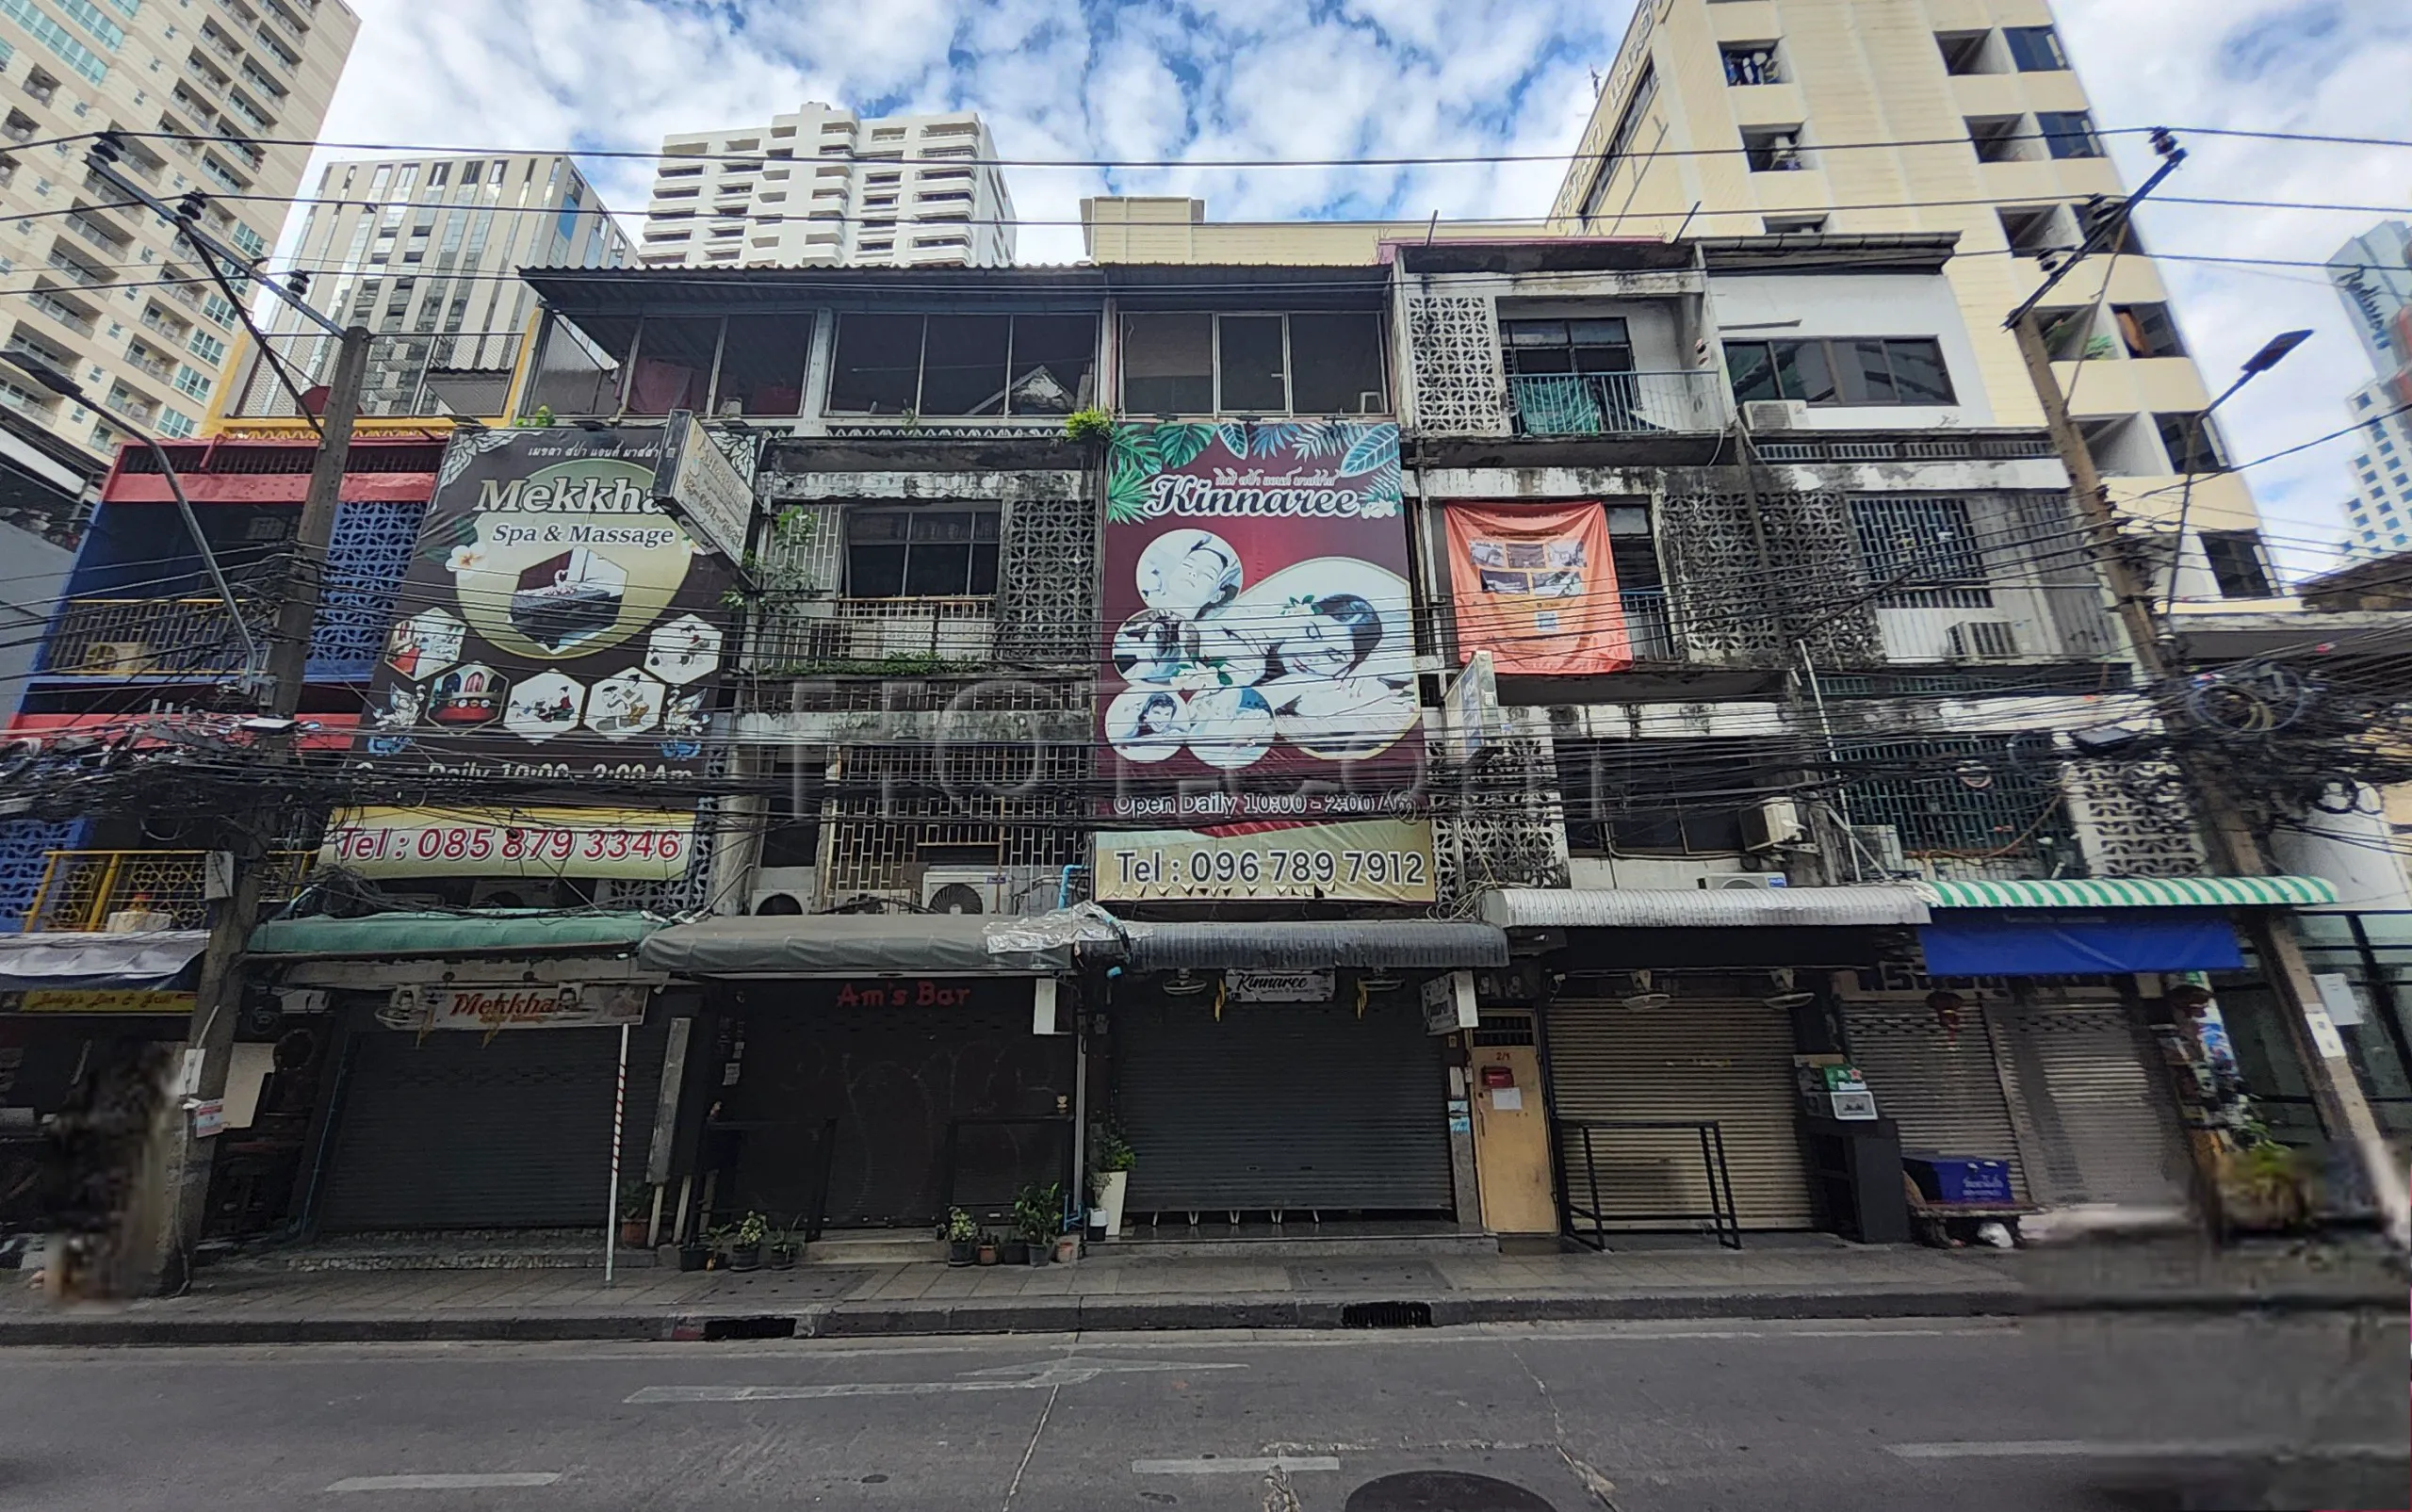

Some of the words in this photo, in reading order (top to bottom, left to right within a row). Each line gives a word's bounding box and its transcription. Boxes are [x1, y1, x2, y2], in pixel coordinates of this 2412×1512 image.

[471, 477, 666, 514] Mekkha
[1144, 475, 1360, 516] Kinnaree
[492, 524, 537, 546] Spa
[544, 525, 563, 543] &
[568, 525, 675, 548] Massage
[1115, 794, 1176, 818] Open
[1181, 792, 1238, 818] Daily
[1244, 794, 1307, 814] 10:00
[339, 827, 390, 861] Tel
[416, 827, 494, 861] 085
[500, 827, 573, 862] 879
[581, 828, 682, 863] 3346
[1115, 851, 1162, 884] Tel
[1190, 851, 1261, 886] 096
[1268, 851, 1336, 886] 789
[1343, 851, 1426, 886] 7912
[837, 981, 908, 1006] Am's
[916, 980, 971, 1006] Bar
[1237, 972, 1308, 992] Kinnaree
[449, 992, 562, 1016] Mekkha
